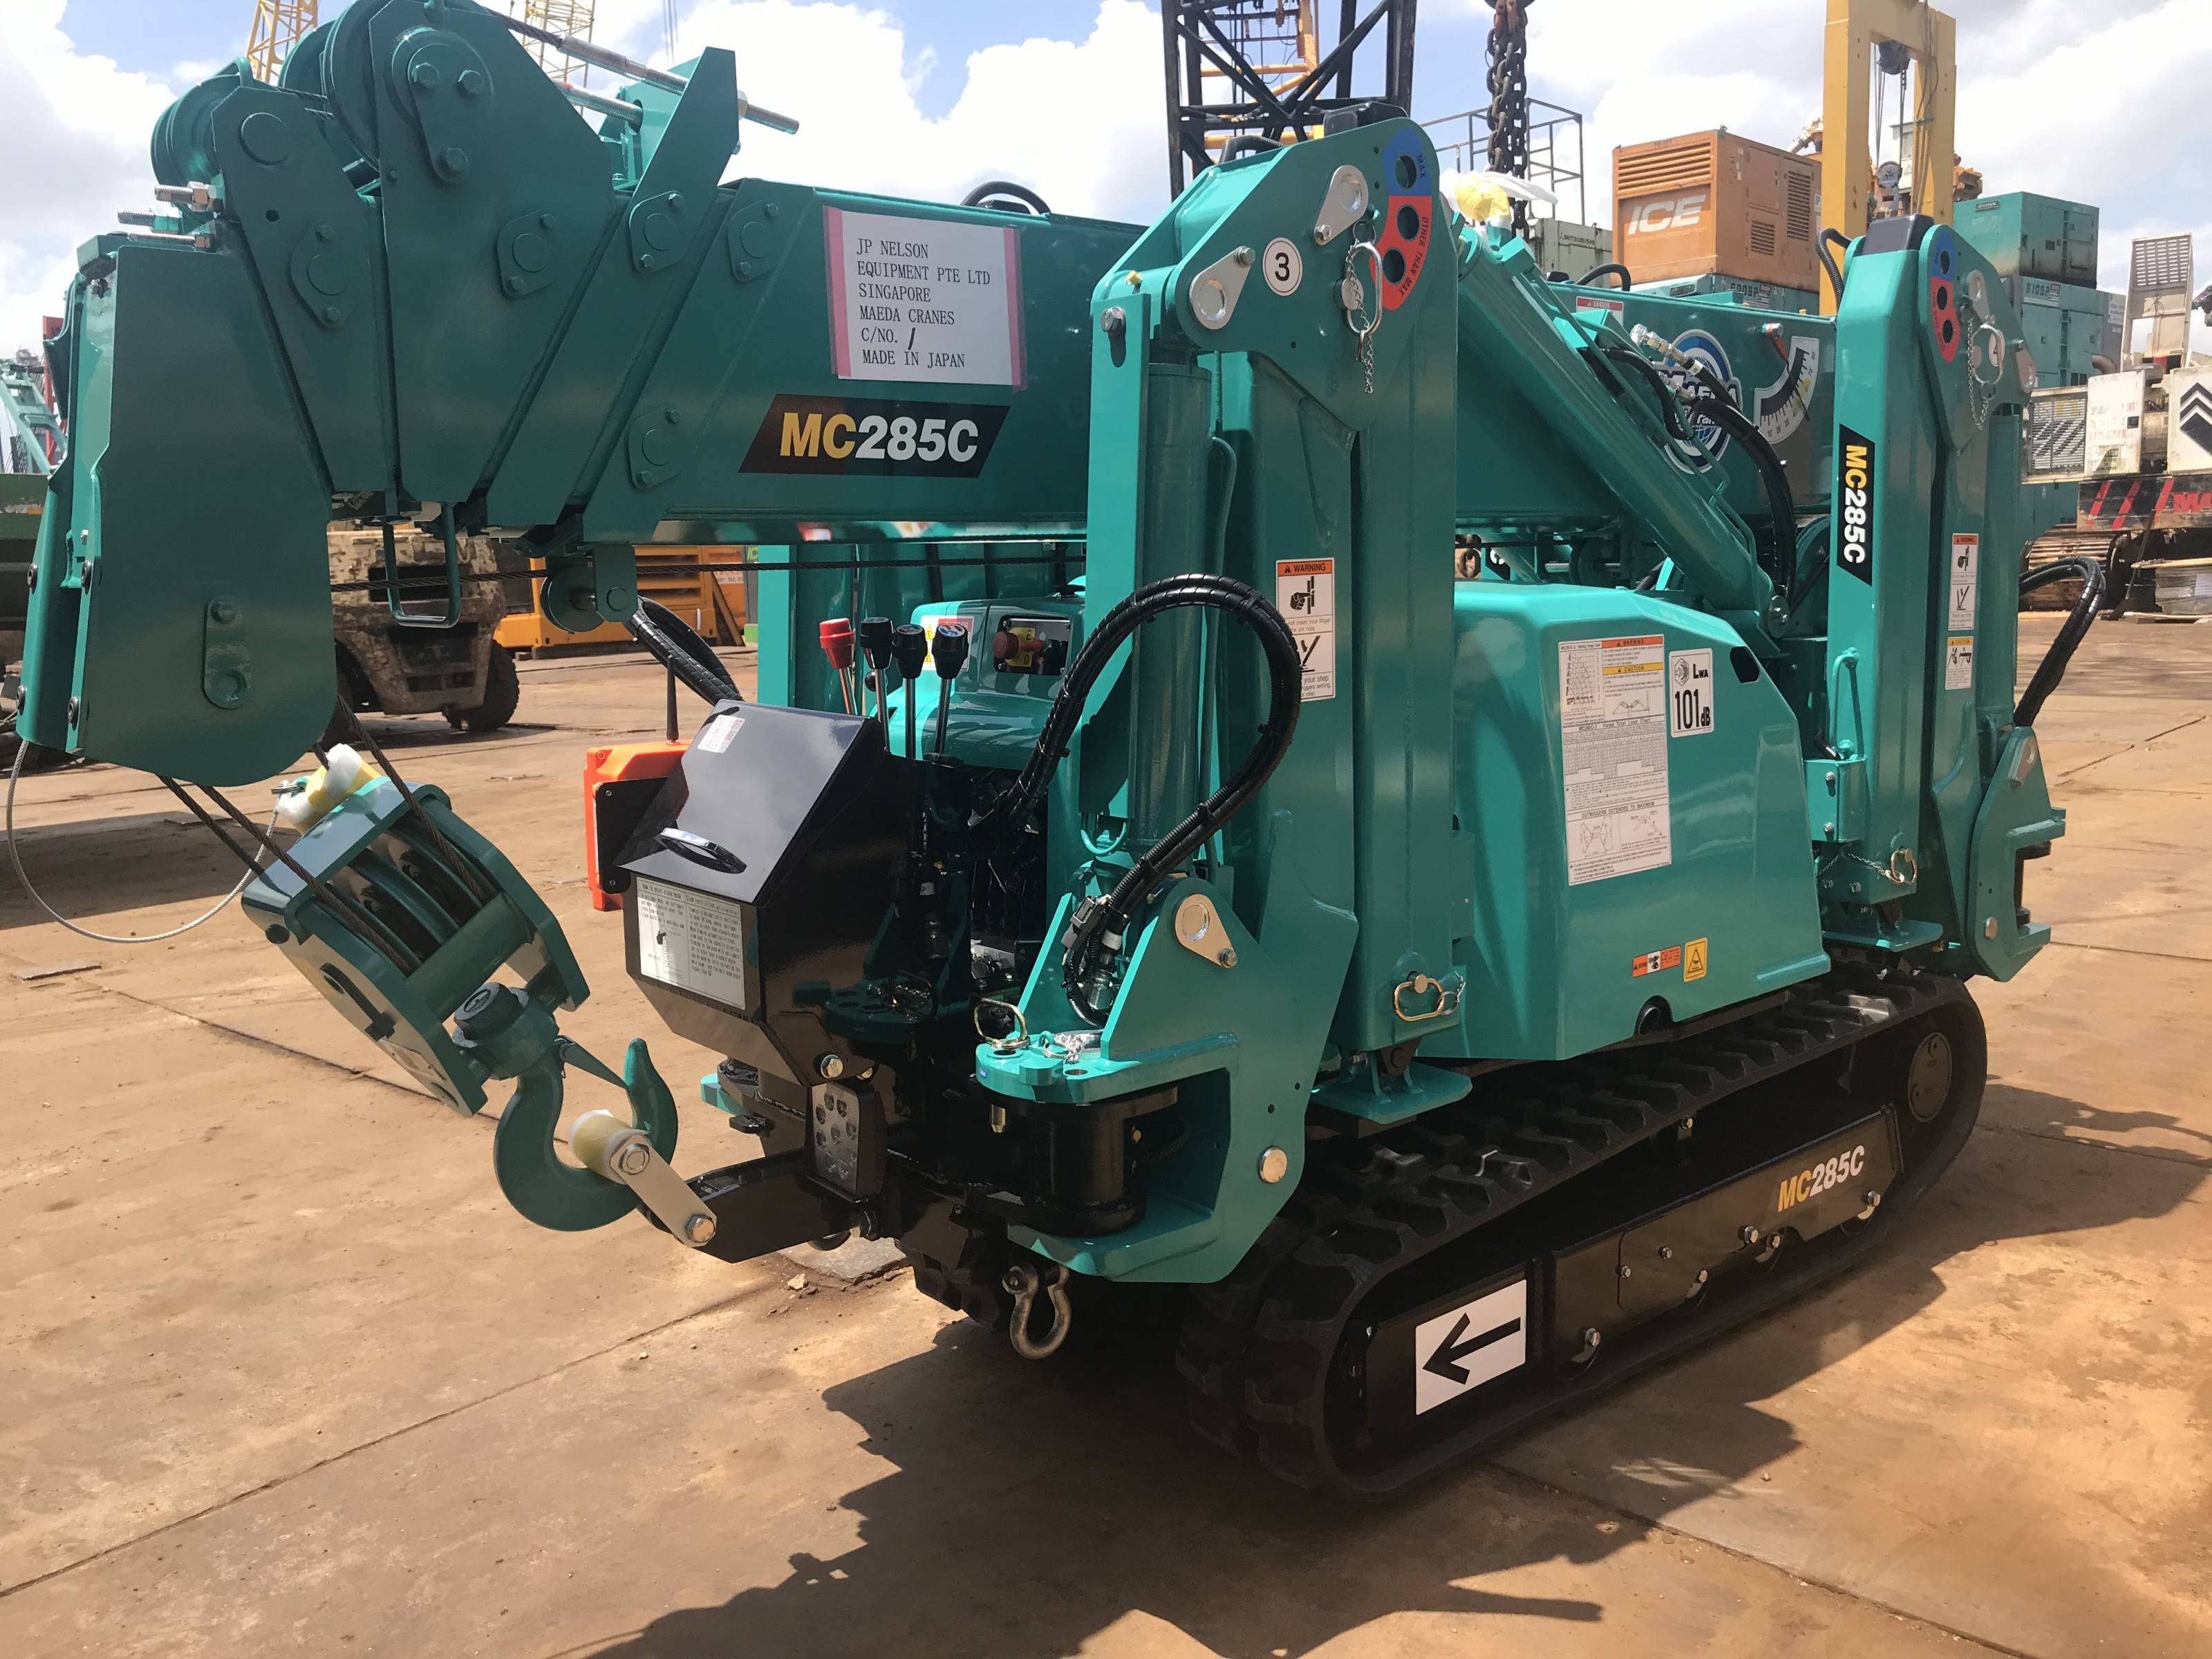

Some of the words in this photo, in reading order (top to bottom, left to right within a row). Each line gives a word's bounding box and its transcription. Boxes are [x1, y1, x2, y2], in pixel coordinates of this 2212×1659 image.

[1416, 155, 1426, 178] MAX
[1627, 194, 1707, 235] ICE
[1419, 216, 1429, 247] OTHER
[857, 238, 872, 255] JP
[881, 241, 928, 259] NELSON
[857, 261, 929, 281] EQUIPMENT
[937, 268, 960, 283] PTE
[968, 270, 991, 285] LTD
[1275, 252, 1290, 282] 3
[1410, 252, 1423, 276] THAN
[859, 283, 931, 302] SINGAPORE
[1399, 276, 1412, 297] MAX
[860, 306, 901, 322] MAEDA
[908, 309, 955, 325] CRANES
[861, 327, 898, 343] C/NO.
[863, 349, 895, 364] MADE
[903, 351, 919, 366] IN
[928, 353, 964, 368] JAPAN
[780, 412, 979, 462] MC285C
[1844, 444, 1867, 564] MC285C
[1293, 563, 1326, 572] WARNING
[1582, 809, 1607, 818] OUTRIGGERS
[1778, 1145, 1864, 1212] MC285C
